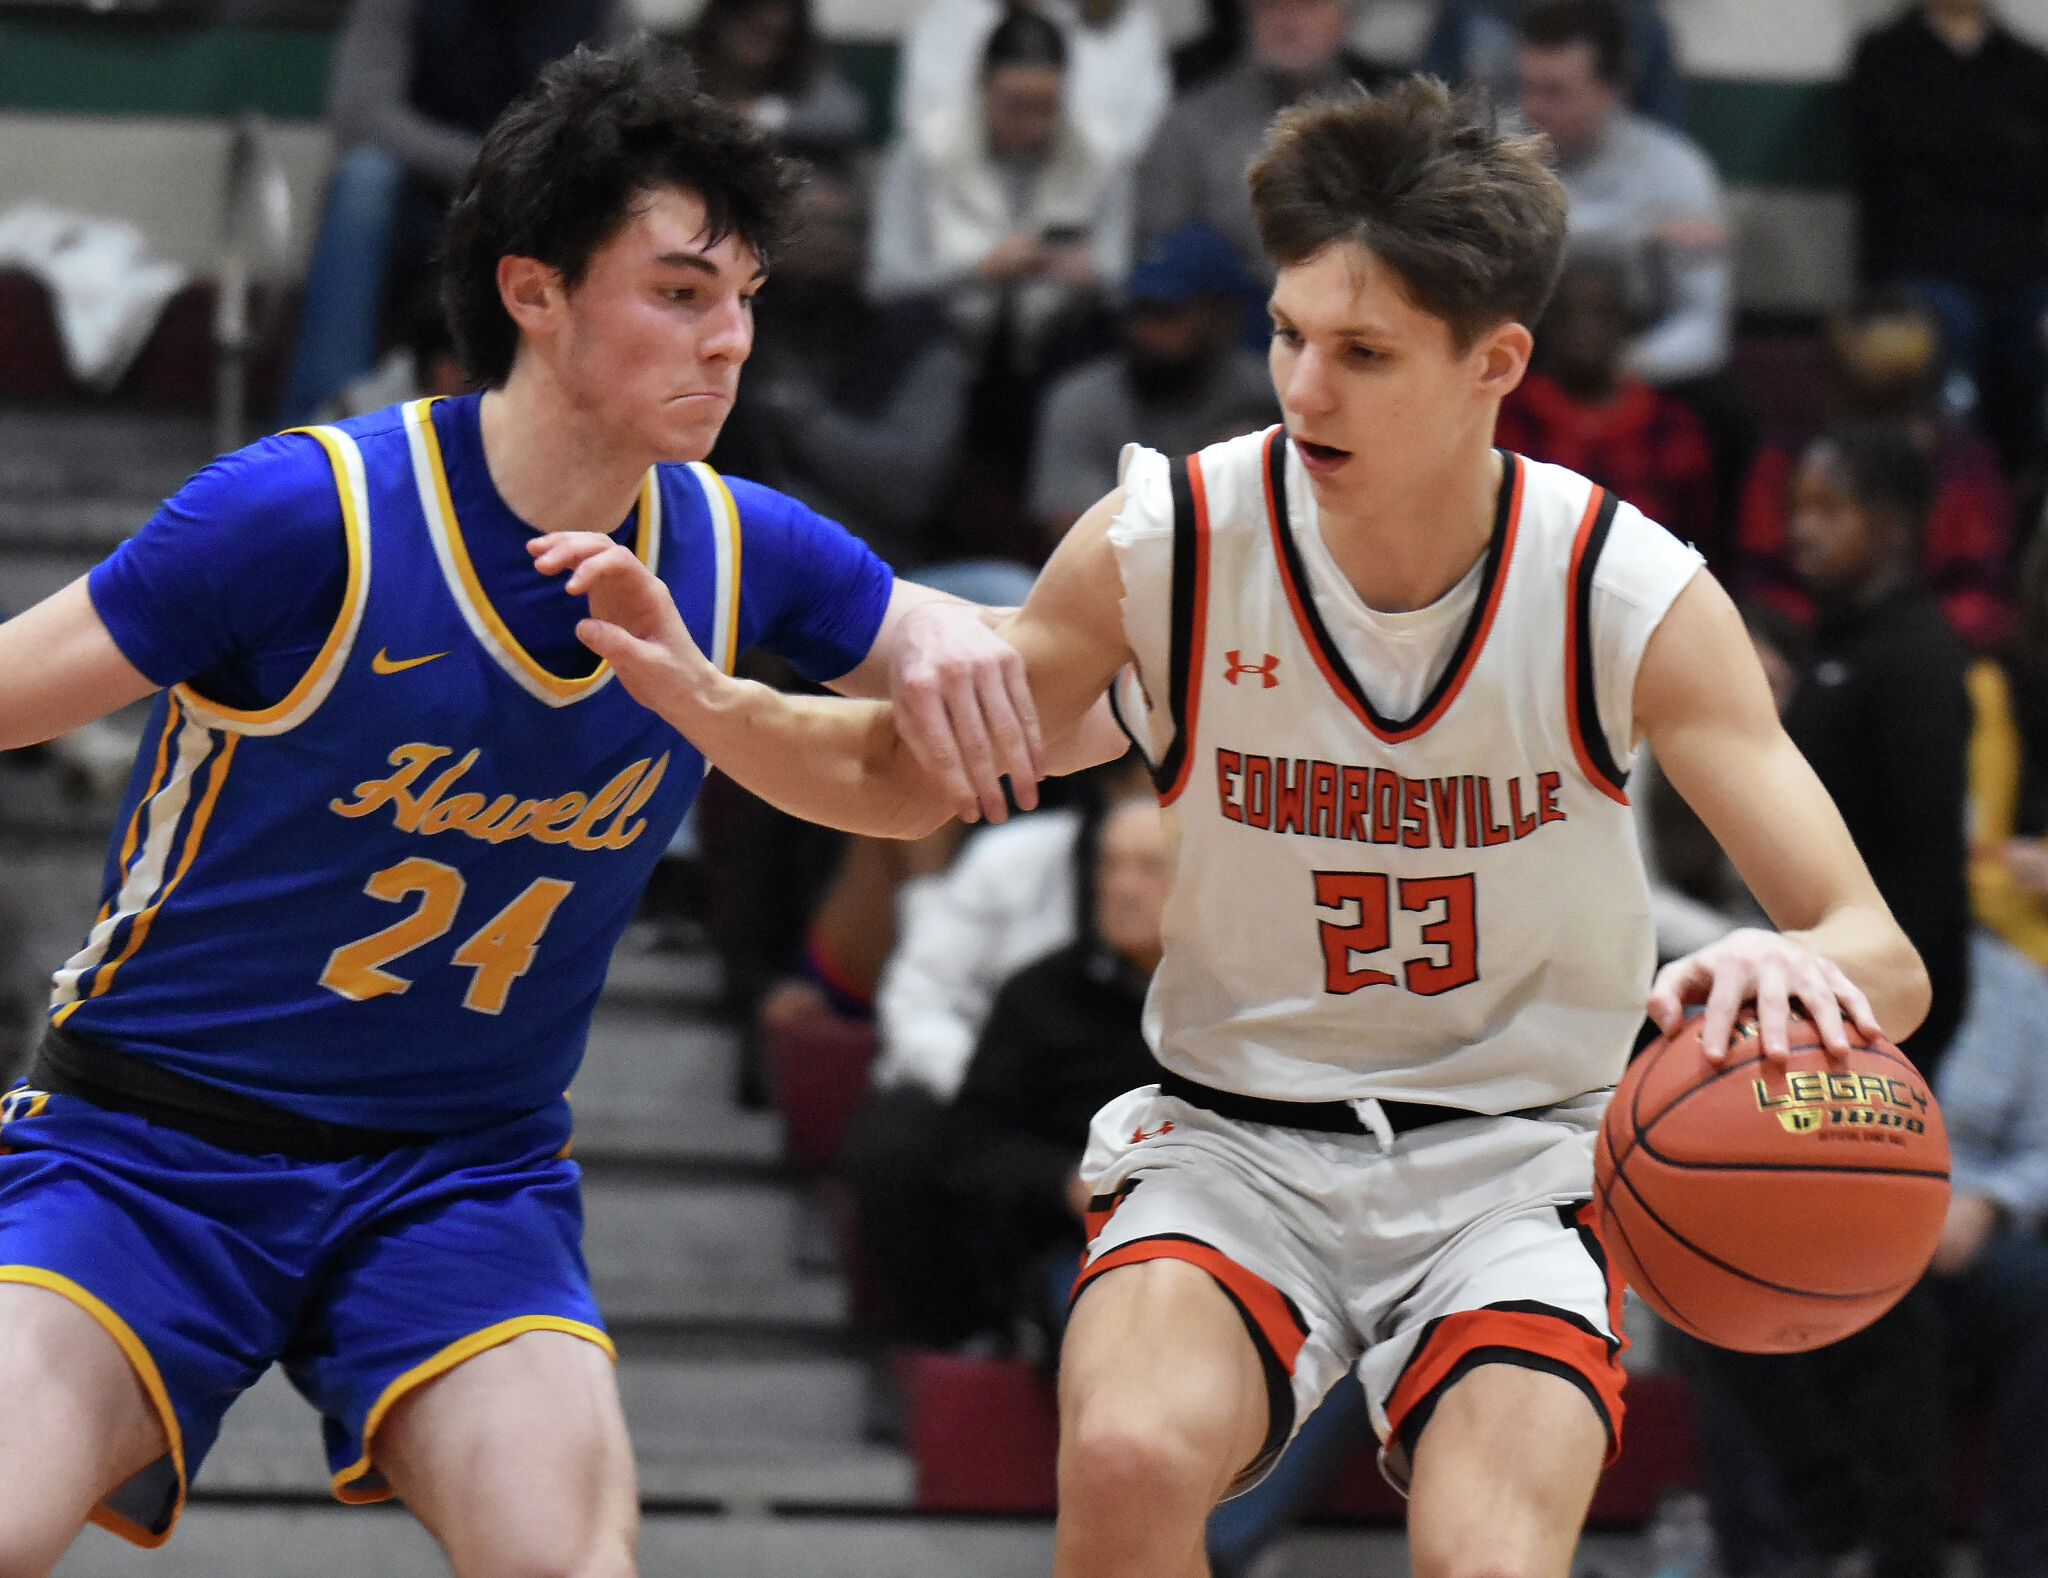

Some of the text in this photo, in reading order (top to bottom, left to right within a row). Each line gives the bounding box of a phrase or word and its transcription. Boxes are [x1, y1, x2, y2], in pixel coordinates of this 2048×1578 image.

[330, 743, 671, 850] Howell
[1216, 748, 1566, 848] EDWARDSVILLE
[319, 856, 576, 1015] 24
[1311, 869, 1479, 996] 23
[1752, 1071, 1928, 1114] LEGACY
